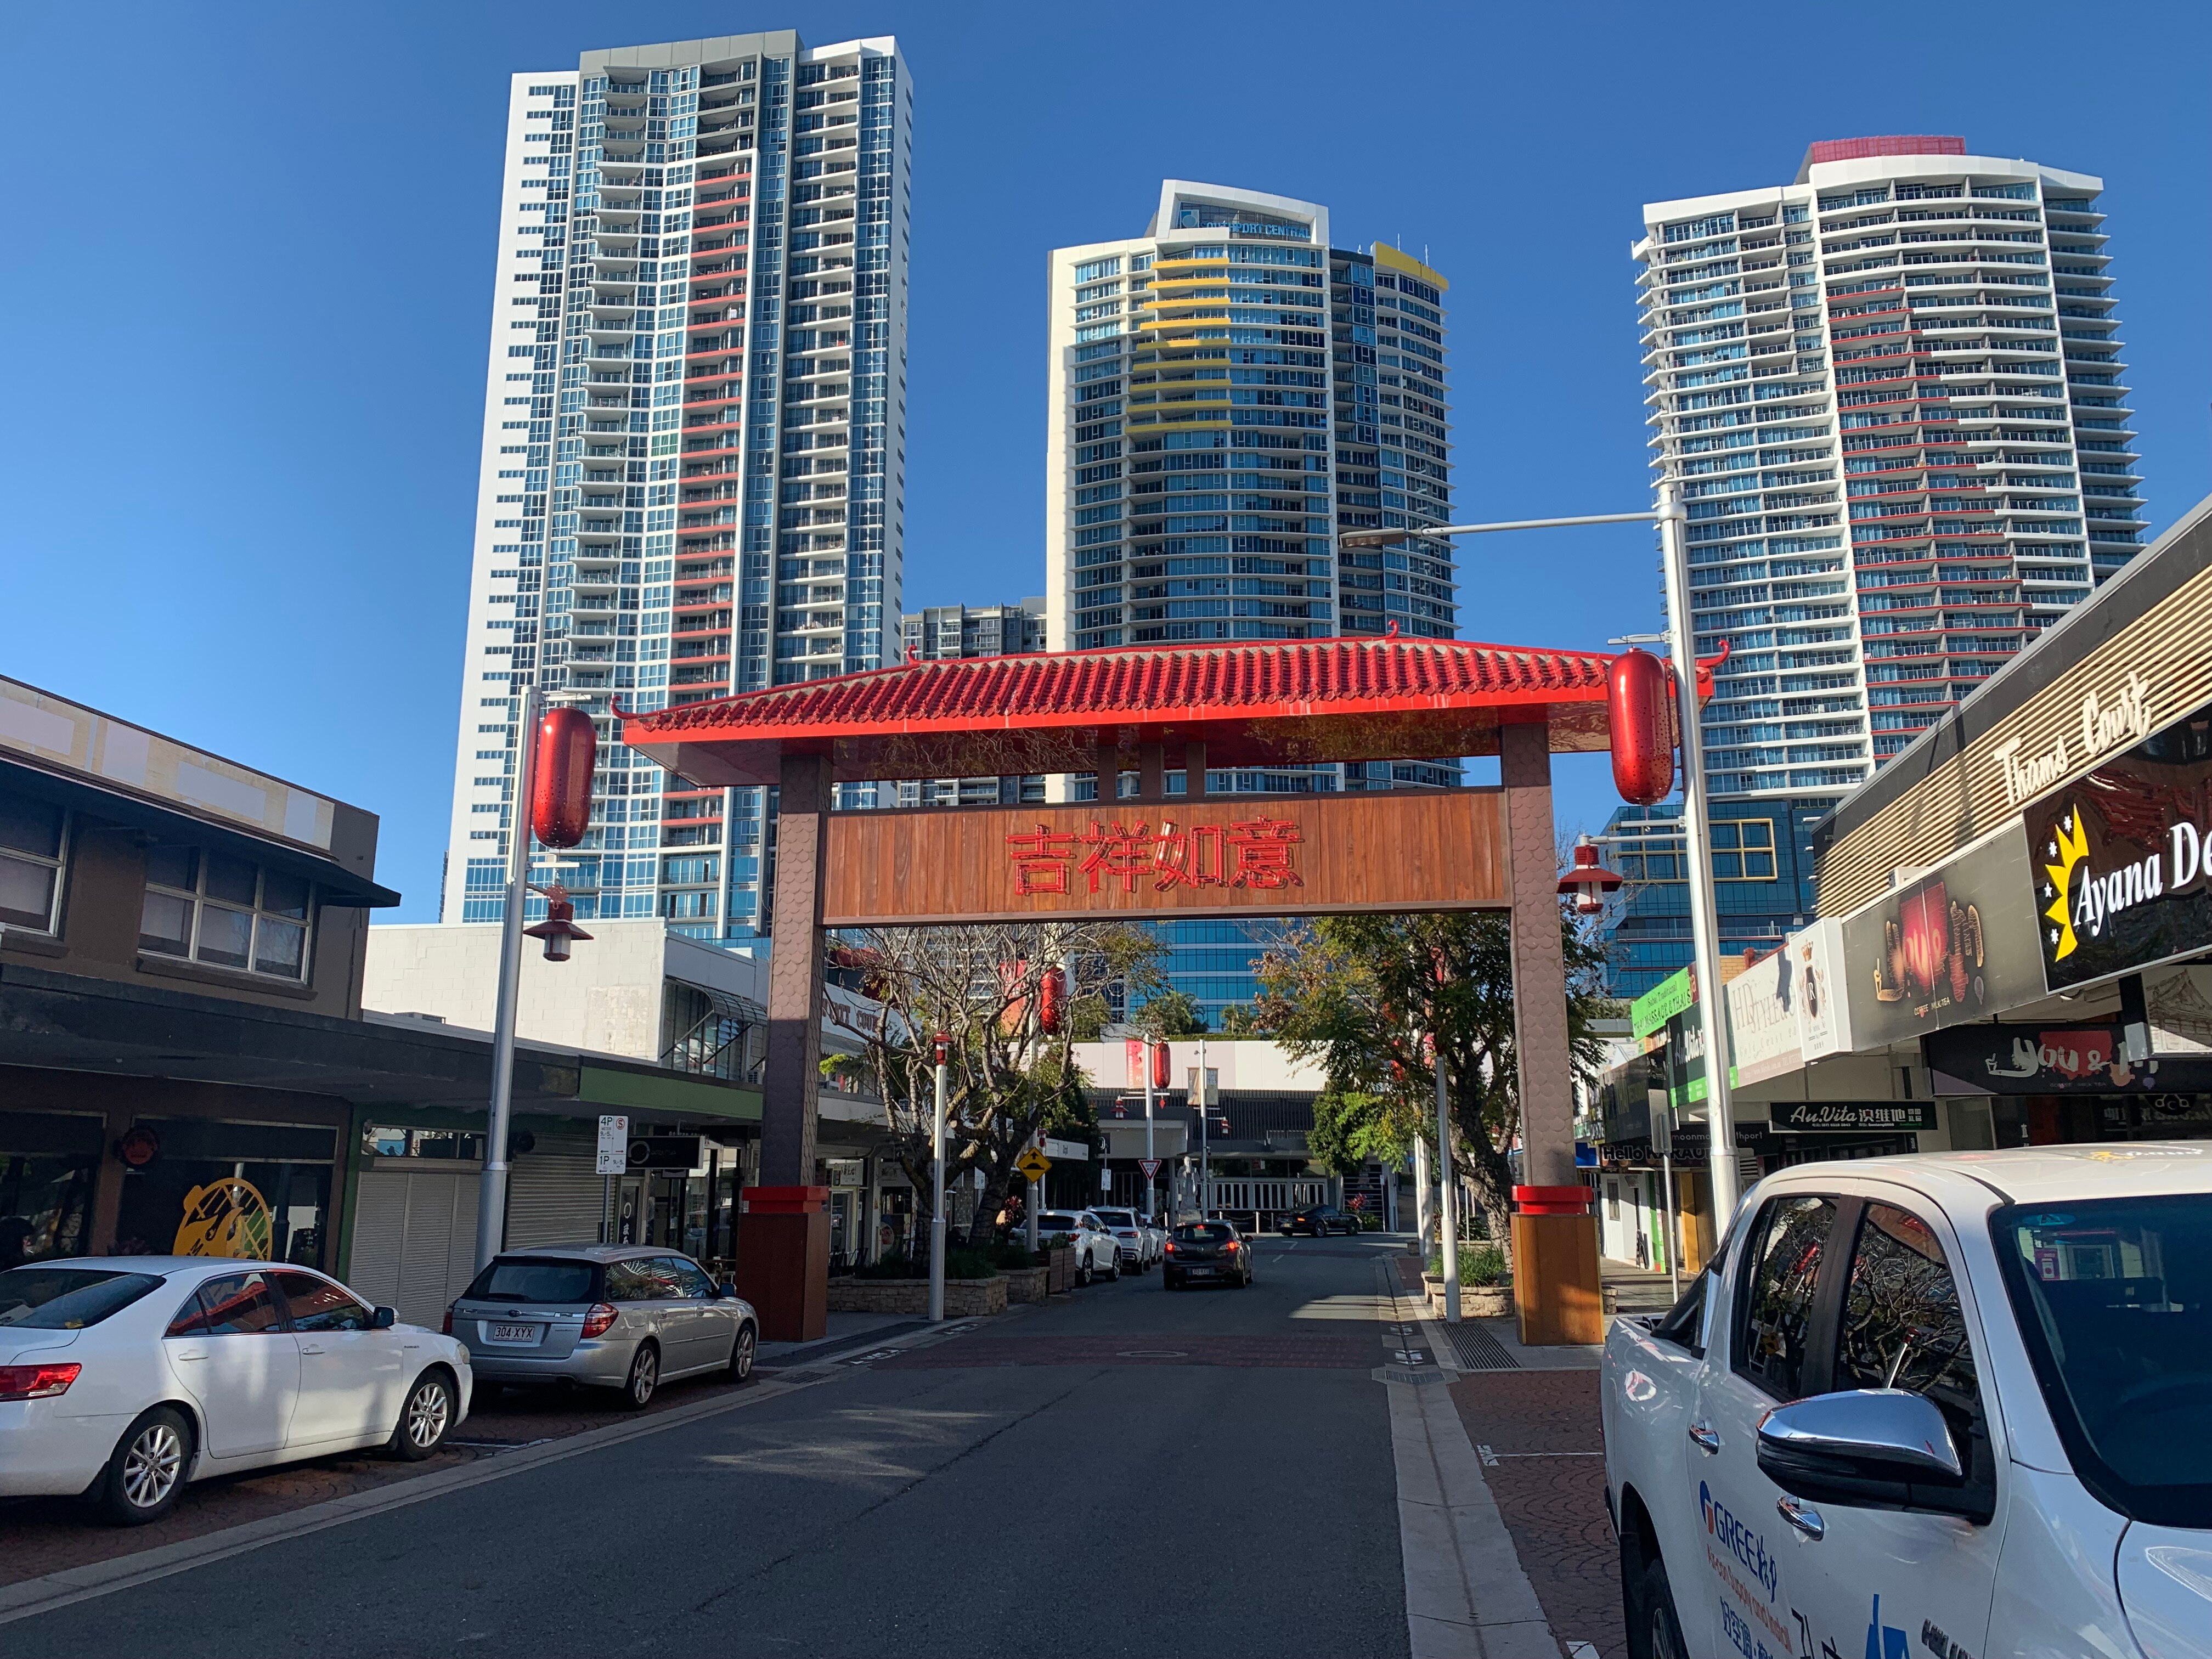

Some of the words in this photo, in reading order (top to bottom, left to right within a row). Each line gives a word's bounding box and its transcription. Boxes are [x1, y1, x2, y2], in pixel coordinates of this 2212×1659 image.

[2083, 671, 2152, 755] Court
[1005, 815, 1304, 895] 吉祥如意
[2073, 853, 2164, 936] Ayana
[2087, 1049, 2111, 1071] &
[601, 1117, 613, 1126] 4P
[1790, 1105, 1858, 1123] Au.Vita
[600, 1156, 610, 1165] 1P
[1602, 1145, 1644, 1161] Hello
[1714, 1500, 1758, 1578] GREE
